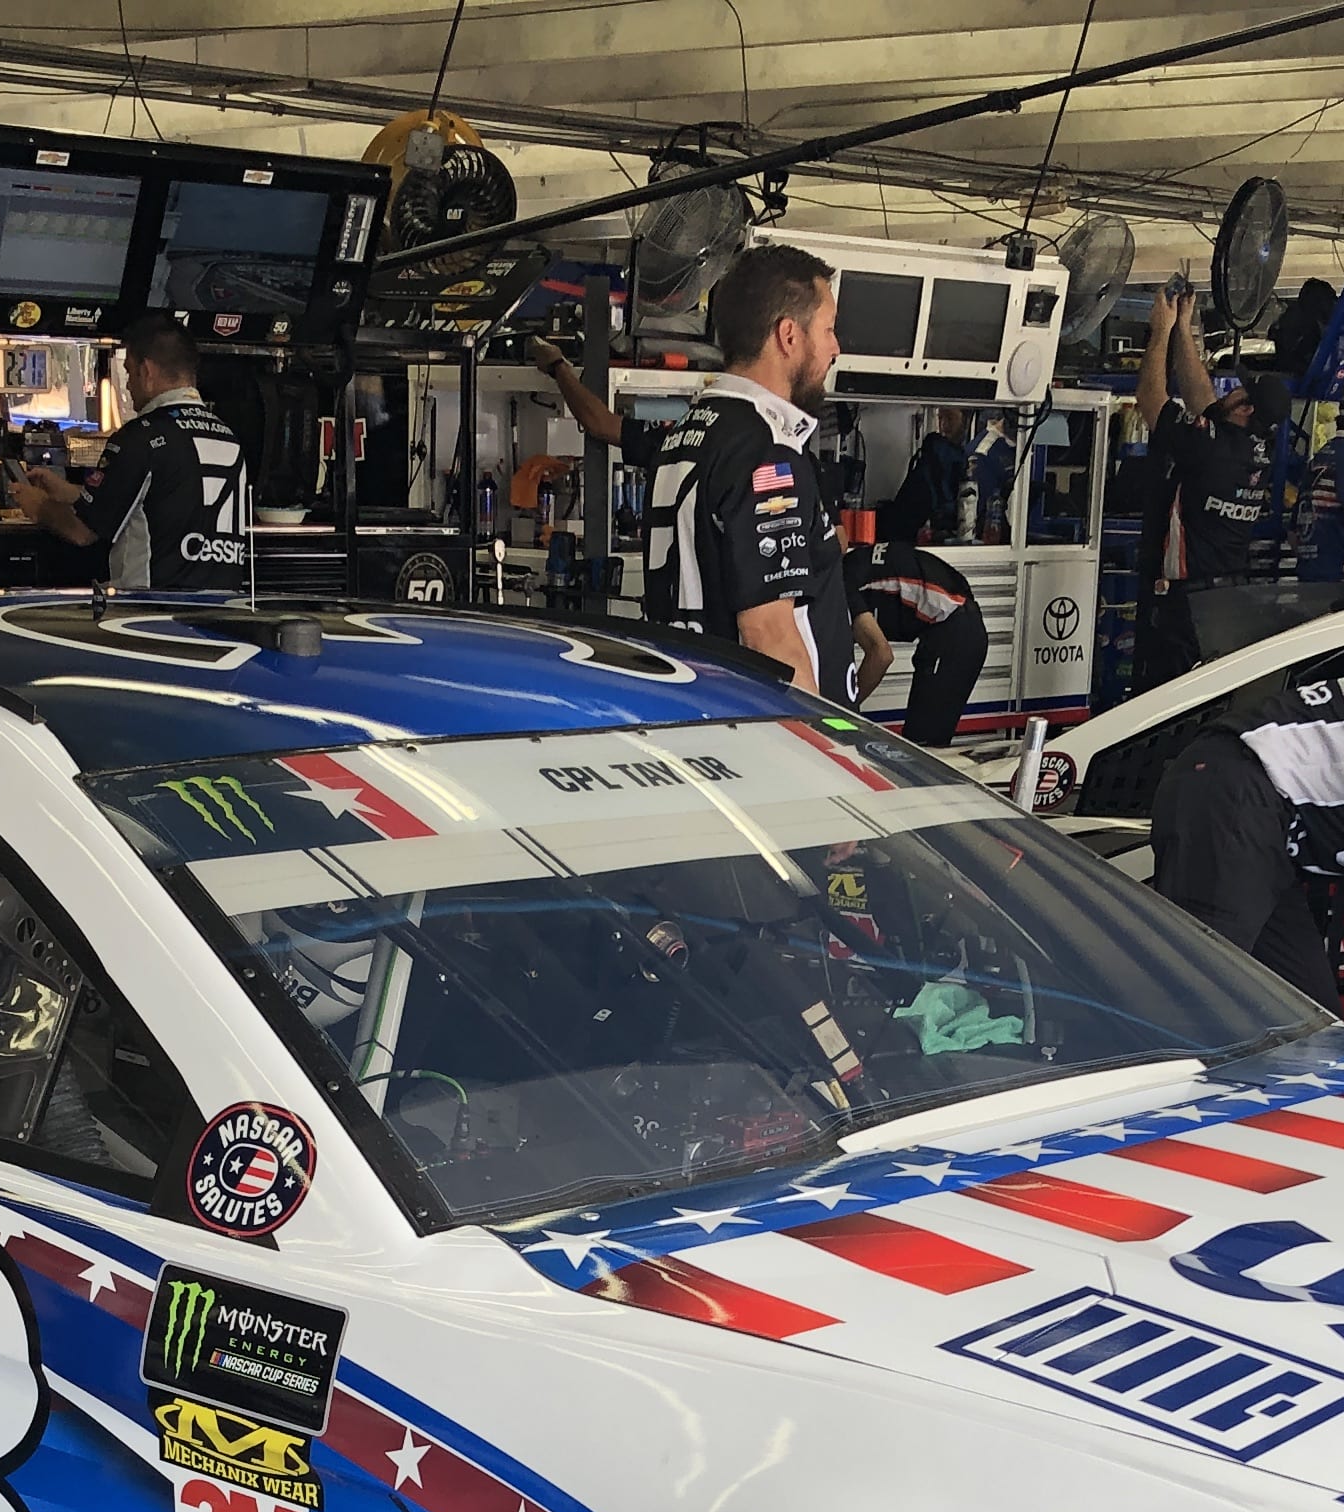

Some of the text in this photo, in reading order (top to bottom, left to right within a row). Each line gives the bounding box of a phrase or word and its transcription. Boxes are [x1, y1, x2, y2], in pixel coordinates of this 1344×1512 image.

[780, 532, 806, 552] ptc
[406, 578, 444, 602] 50
[764, 567, 808, 583] EMERSON
[1033, 644, 1084, 665] TOYOTA
[539, 755, 743, 793] CPL TAYOR
[218, 1104, 305, 1157] NASCAR
[194, 1173, 284, 1227] SALUTES
[217, 1305, 328, 1356] MONSTER
[228, 1337, 308, 1367] ENERGY
[222, 1354, 320, 1394] NASCAR CUP SERIES
[163, 1434, 320, 1507] MECHANIX WEAR
